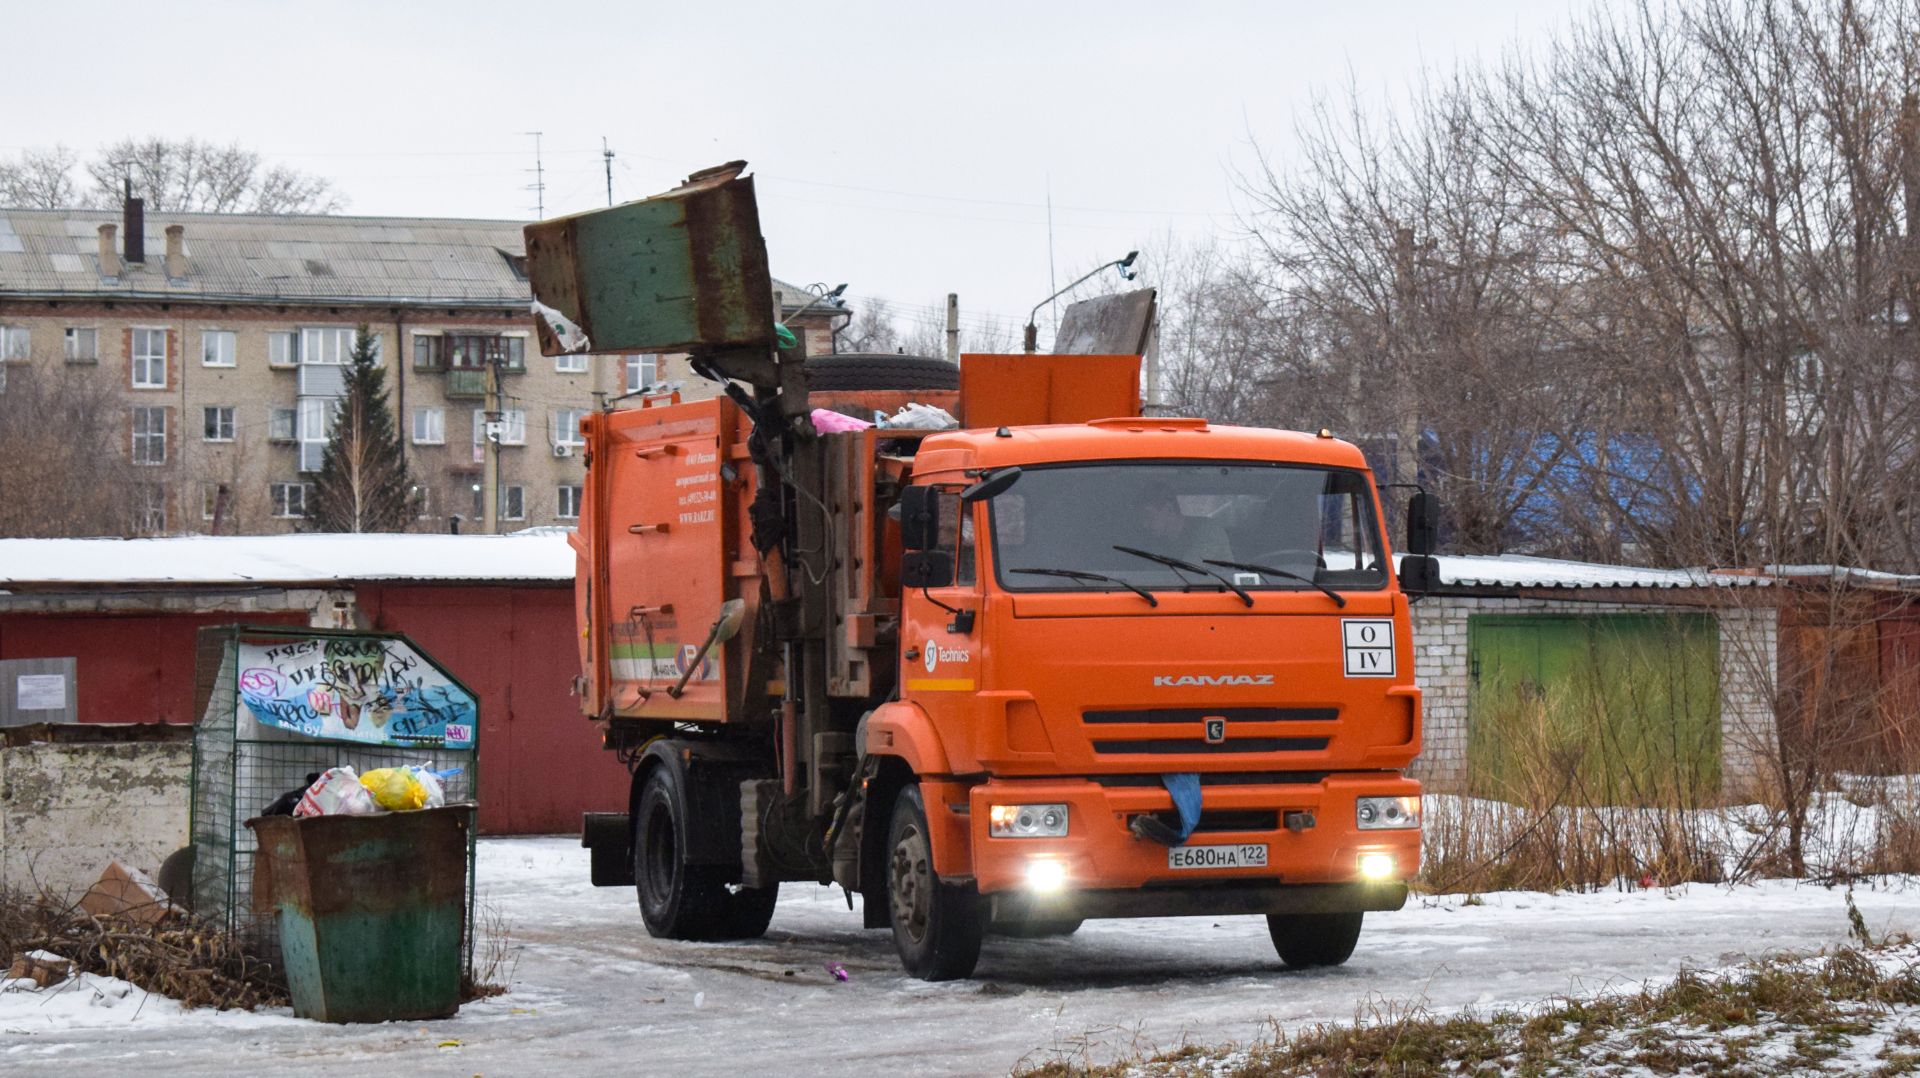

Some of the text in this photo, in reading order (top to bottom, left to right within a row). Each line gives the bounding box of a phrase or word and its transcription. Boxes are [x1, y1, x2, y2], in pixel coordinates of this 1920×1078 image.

[938, 645, 969, 663] Technics
[1358, 651, 1383, 669] IV
[1153, 674, 1275, 687] KAMAZ
[1240, 846, 1264, 860] 122
